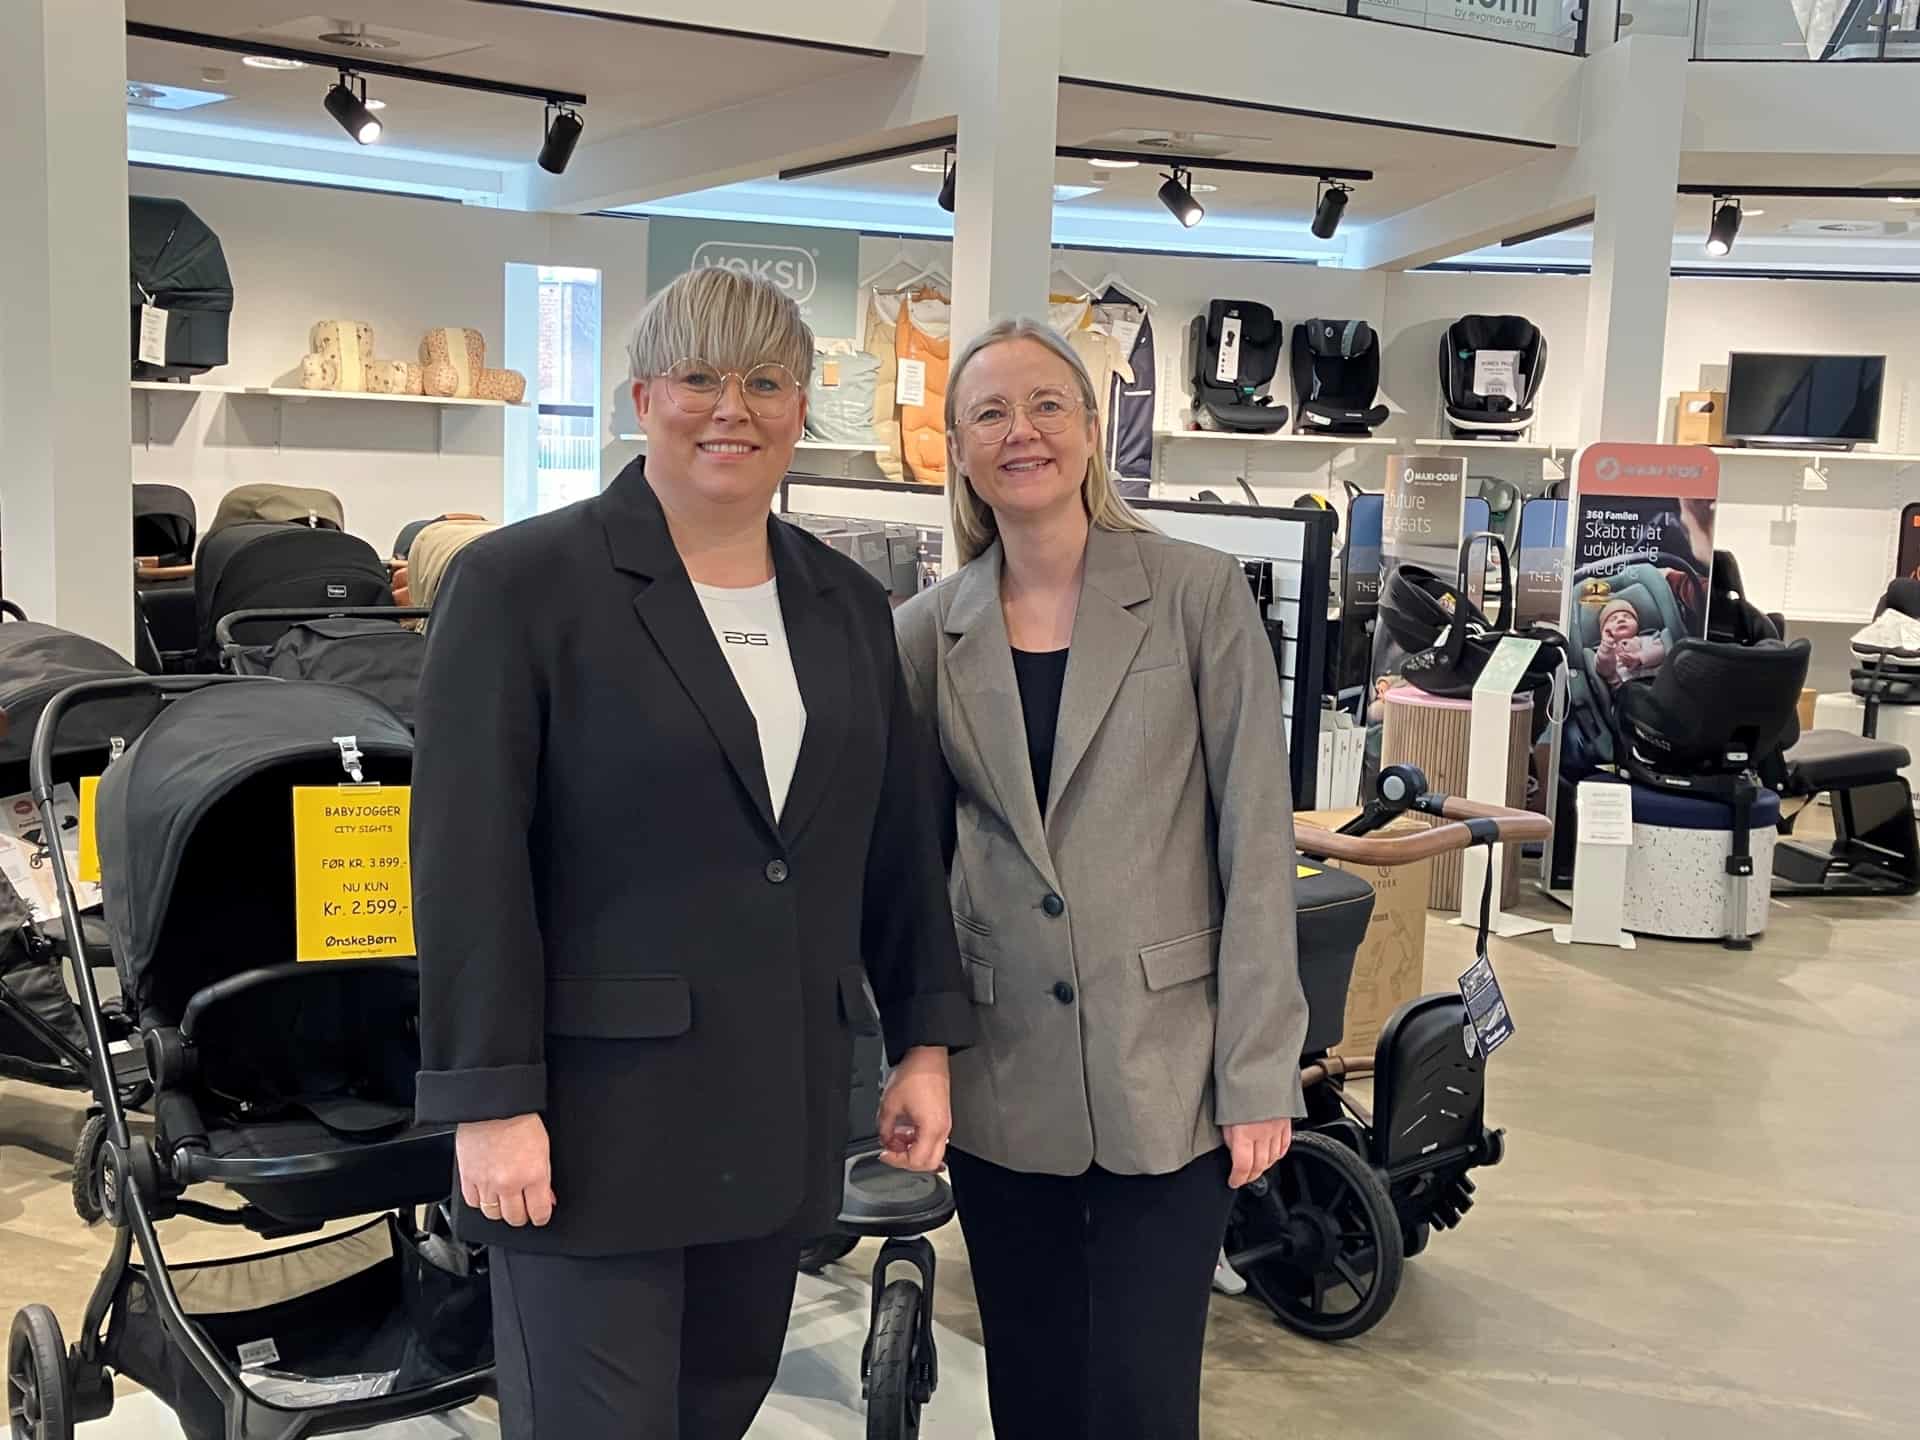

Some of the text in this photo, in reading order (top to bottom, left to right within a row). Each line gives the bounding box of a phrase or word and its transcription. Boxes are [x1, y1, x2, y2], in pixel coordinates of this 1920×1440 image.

[1585, 510, 1604, 520] 360
[1585, 522, 1662, 541] Skabt til at
[1583, 541, 1659, 562] udvikle sig
[334, 825, 393, 834] CITY SIGHTS
[321, 858, 345, 870] FØR
[342, 881, 389, 893] NU KUN
[323, 900, 347, 917] Kr.
[325, 934, 397, 947] ØnskeBørn
